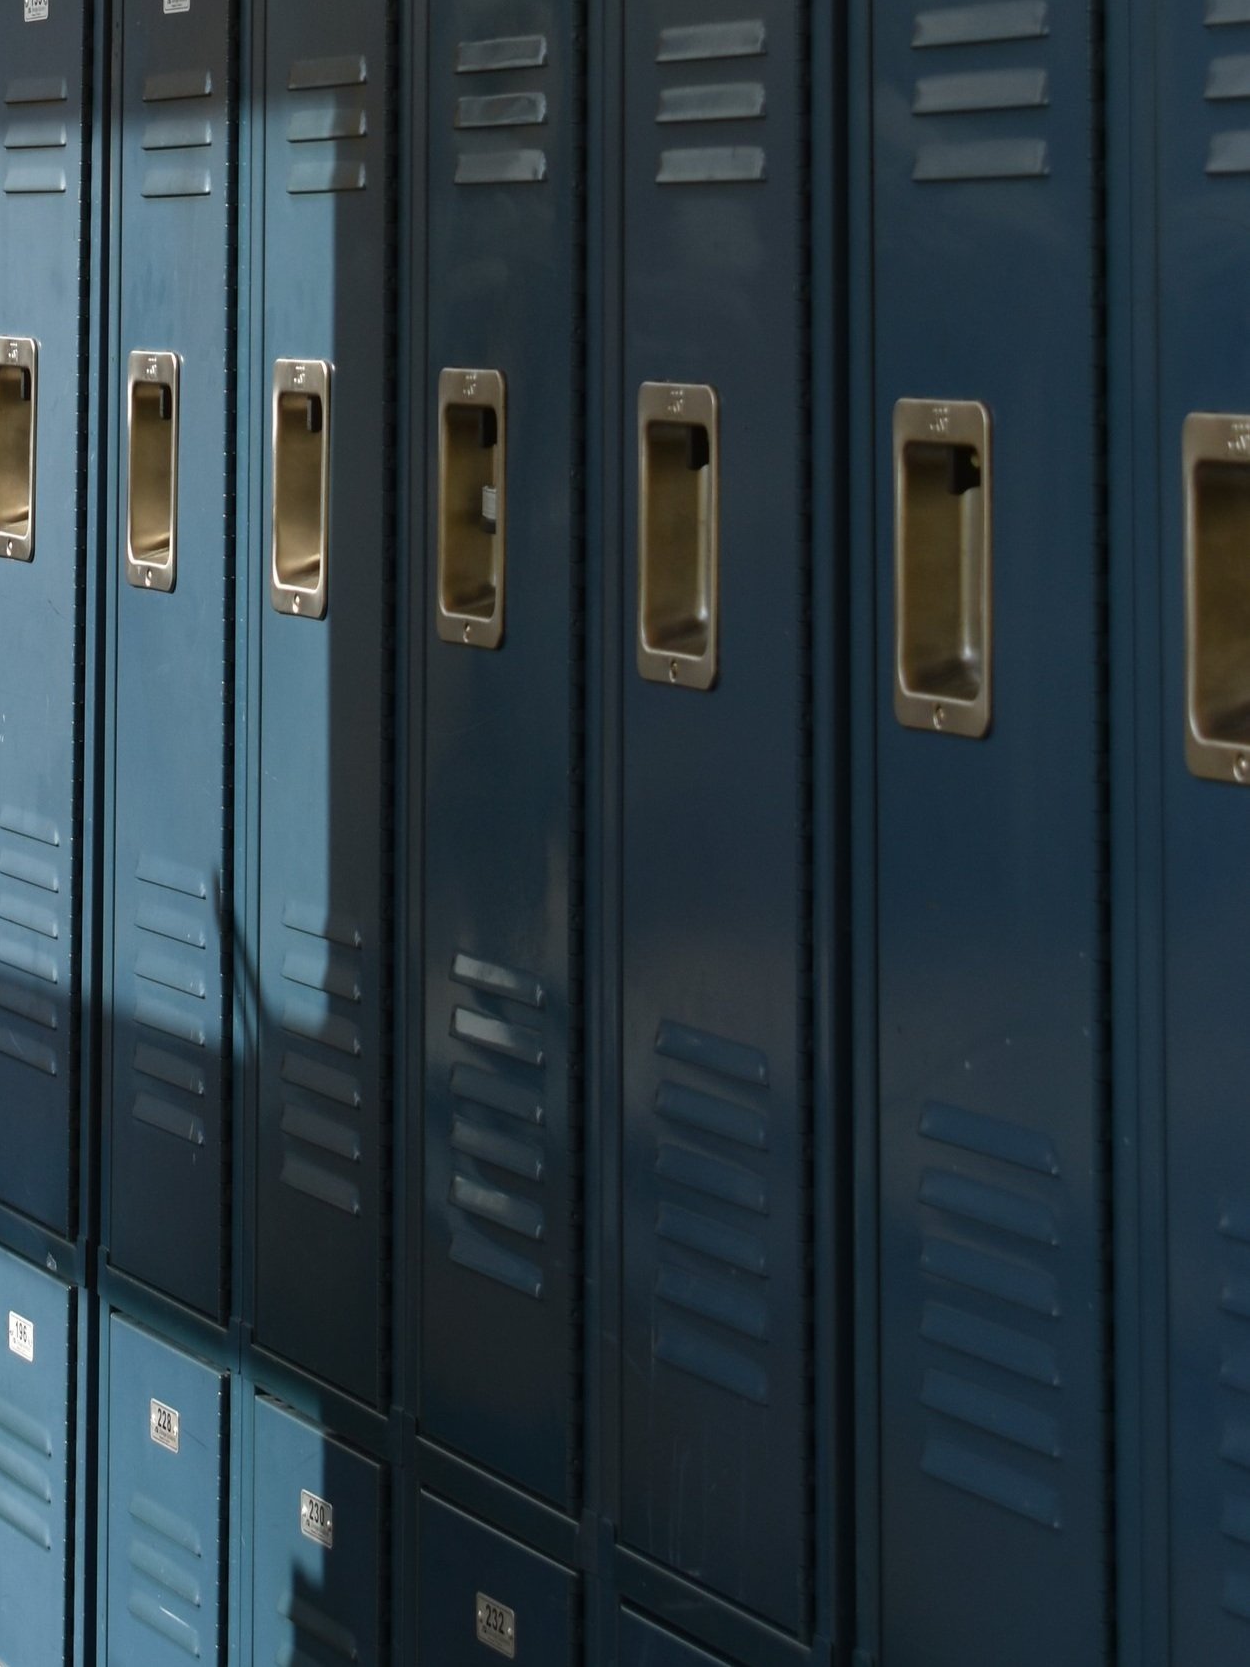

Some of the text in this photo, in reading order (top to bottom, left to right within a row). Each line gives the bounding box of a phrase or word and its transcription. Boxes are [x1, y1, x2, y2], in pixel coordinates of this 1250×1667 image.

[15, 1320, 27, 1343] 196
[157, 1408, 172, 1432] 228
[309, 1499, 324, 1526] 230
[485, 1604, 505, 1634] 232
